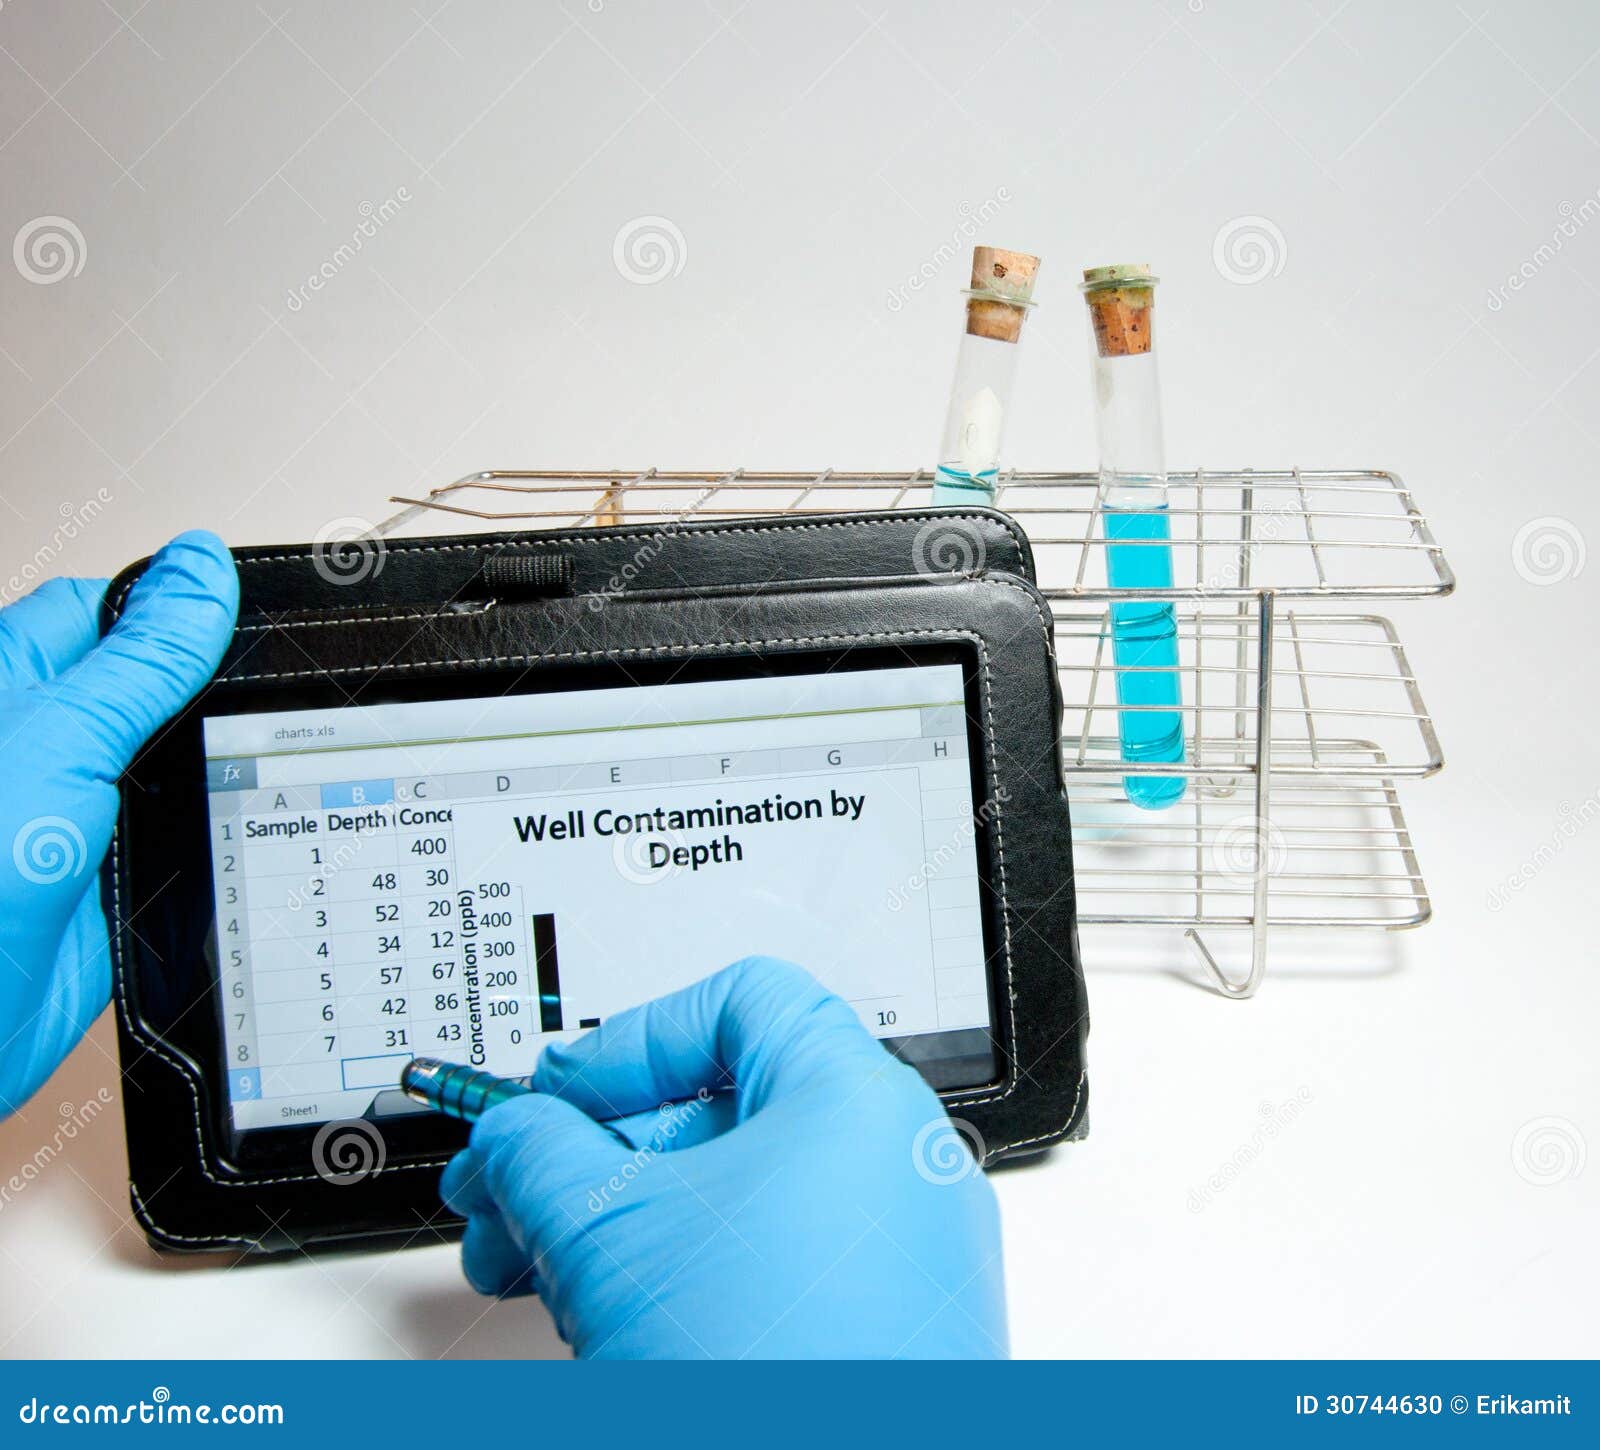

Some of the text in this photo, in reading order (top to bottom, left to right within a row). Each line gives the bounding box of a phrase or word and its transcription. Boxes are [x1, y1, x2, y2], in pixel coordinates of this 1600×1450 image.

[274, 724, 335, 740] charts.xls
[223, 765, 241, 784] fx
[273, 741, 947, 809] A B C D E F G H
[222, 824, 233, 841] 1
[245, 818, 319, 840] Sample
[328, 809, 388, 834] Depth
[513, 788, 866, 843] Well Contamination by
[223, 838, 447, 873] 2 1 400
[649, 835, 743, 871] Depth
[225, 869, 449, 905] 3 2 48 30
[479, 881, 511, 898] 500
[227, 901, 452, 936] 4 3 52 20
[480, 911, 512, 928] 400
[231, 931, 455, 967] 5 4 34 12
[483, 941, 515, 958] 300
[232, 963, 456, 999] 6 5 57 67
[457, 889, 486, 1066] Concentration (ppb)
[485, 970, 517, 987] 200
[234, 993, 459, 1031] 7 6 42 86
[489, 1001, 519, 1017] 100
[878, 1010, 897, 1027] 10
[237, 1024, 462, 1063] 8 7 31 43
[510, 1030, 522, 1046] 0
[239, 1076, 252, 1093] 9
[281, 1104, 319, 1118] Sheet1
